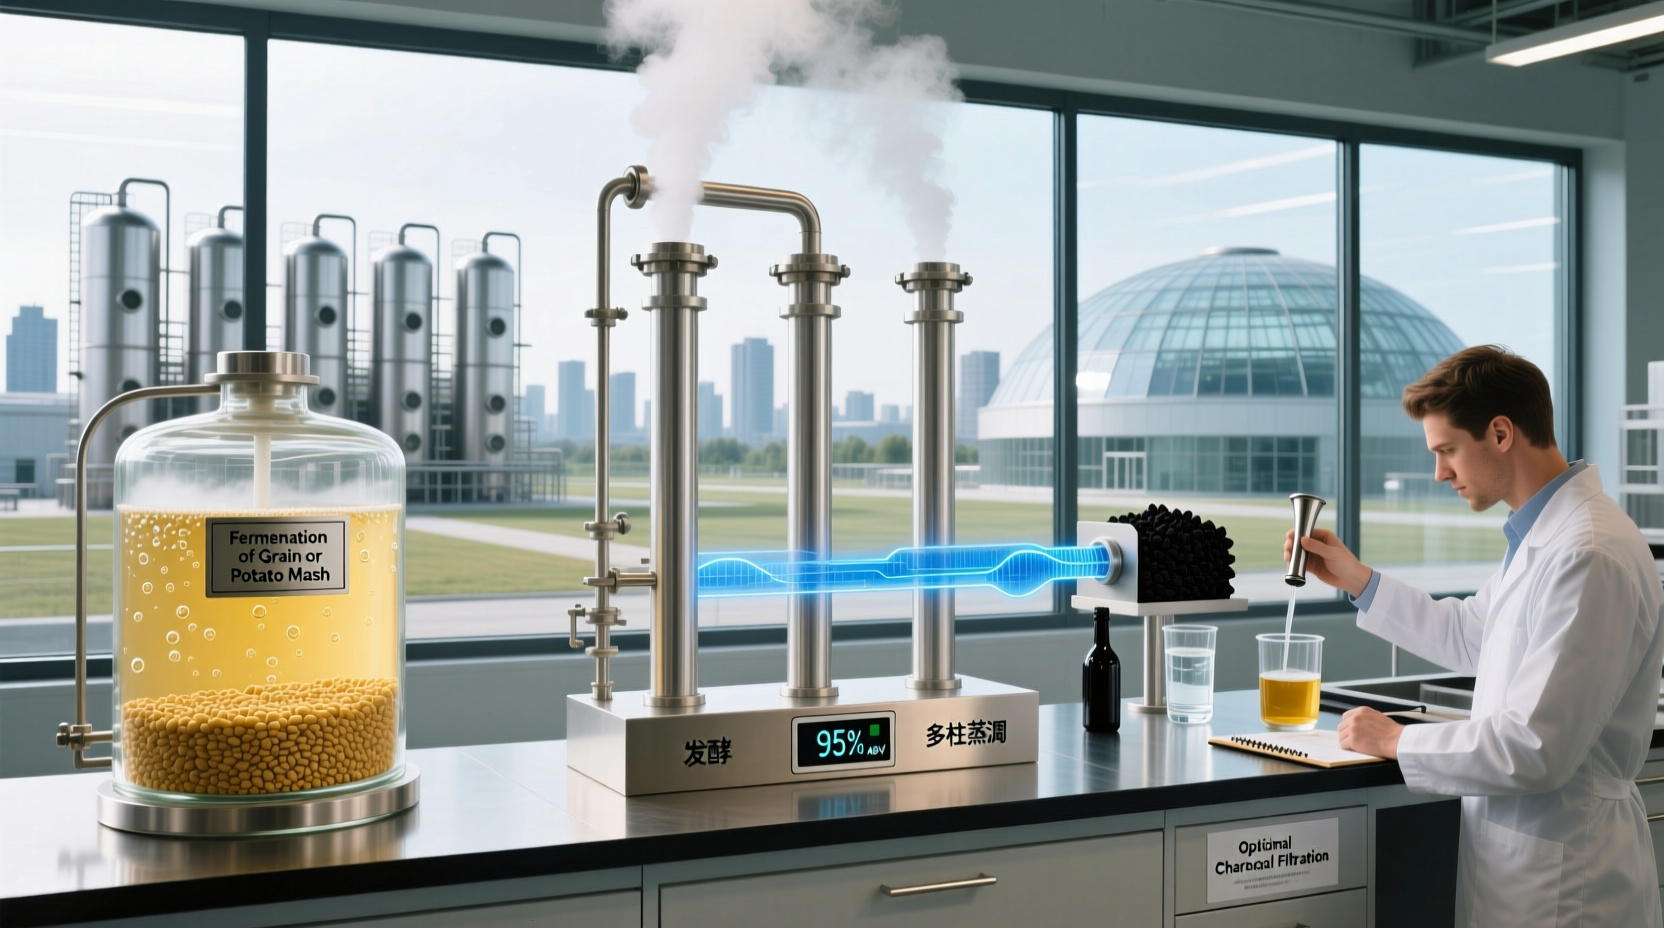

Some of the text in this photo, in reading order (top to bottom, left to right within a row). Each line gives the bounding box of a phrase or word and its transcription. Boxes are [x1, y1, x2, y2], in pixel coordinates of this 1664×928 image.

[229, 529, 328, 545] Fermenation
[238, 548, 323, 564] of Grain or
[230, 566, 331, 583] Potato Mash
[682, 736, 733, 767] 发酵
[816, 729, 886, 758] 95% ABV
